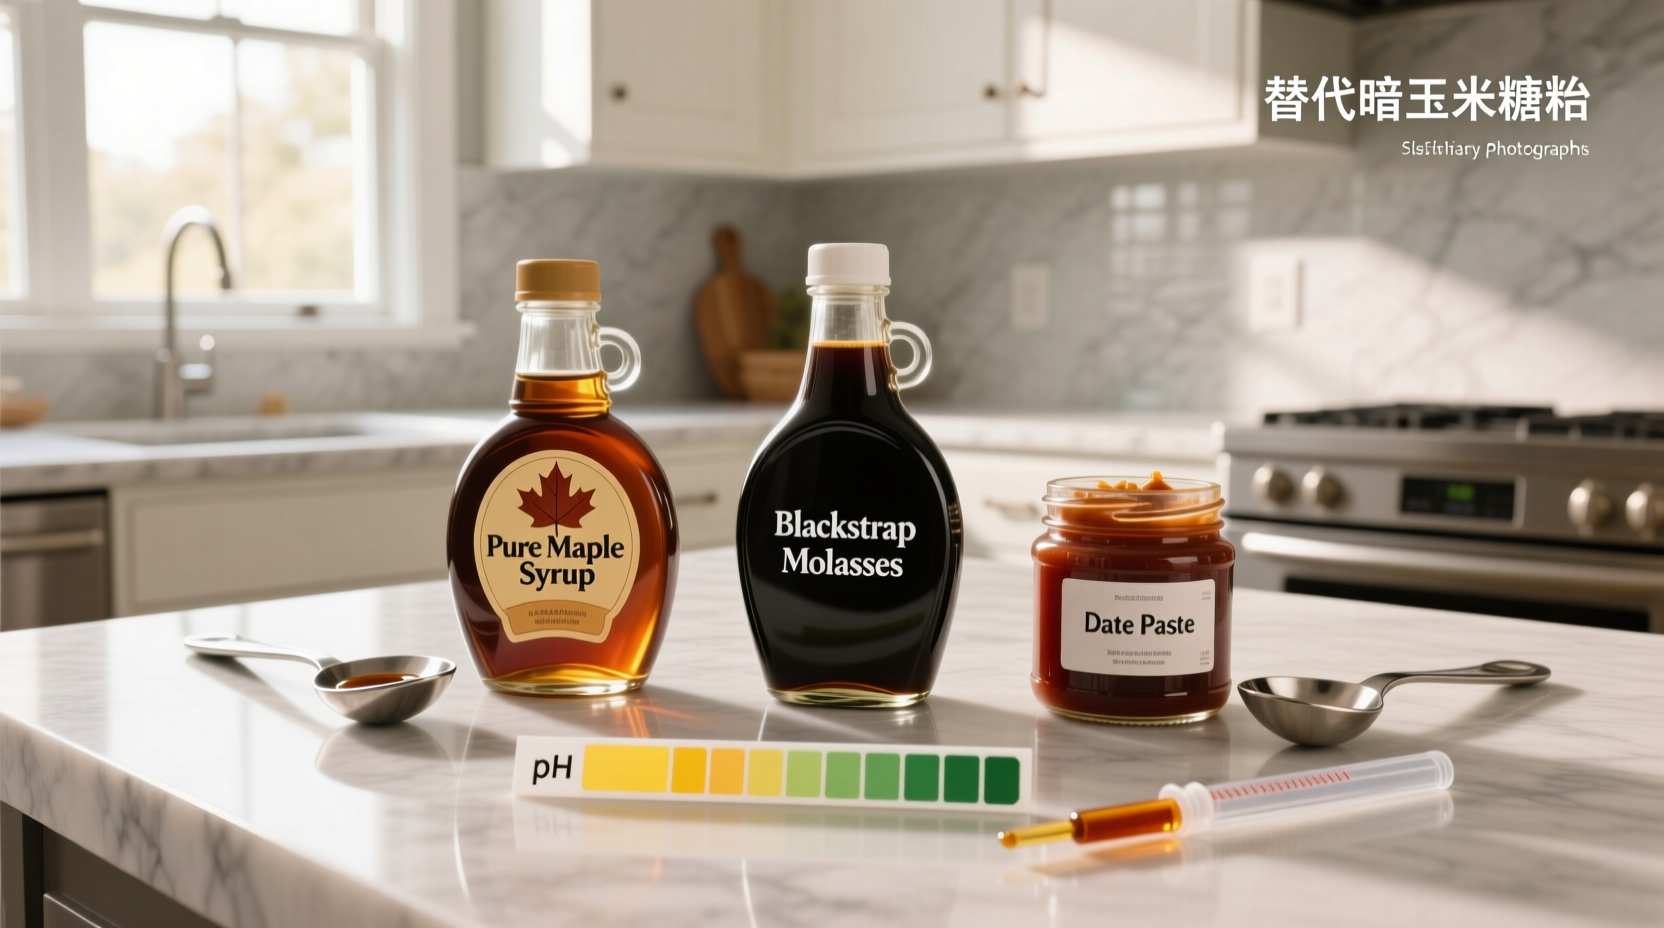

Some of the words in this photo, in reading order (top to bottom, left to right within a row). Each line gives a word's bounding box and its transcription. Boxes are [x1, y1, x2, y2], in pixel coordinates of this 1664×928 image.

[774, 509, 917, 549] Blackstrap
[486, 534, 542, 558] Pure
[547, 534, 625, 565] Maple
[781, 547, 904, 577] Molasses
[519, 561, 596, 592] Syrup
[1084, 611, 1135, 635] Date
[1140, 613, 1195, 636] Paste
[532, 754, 573, 785] pH
